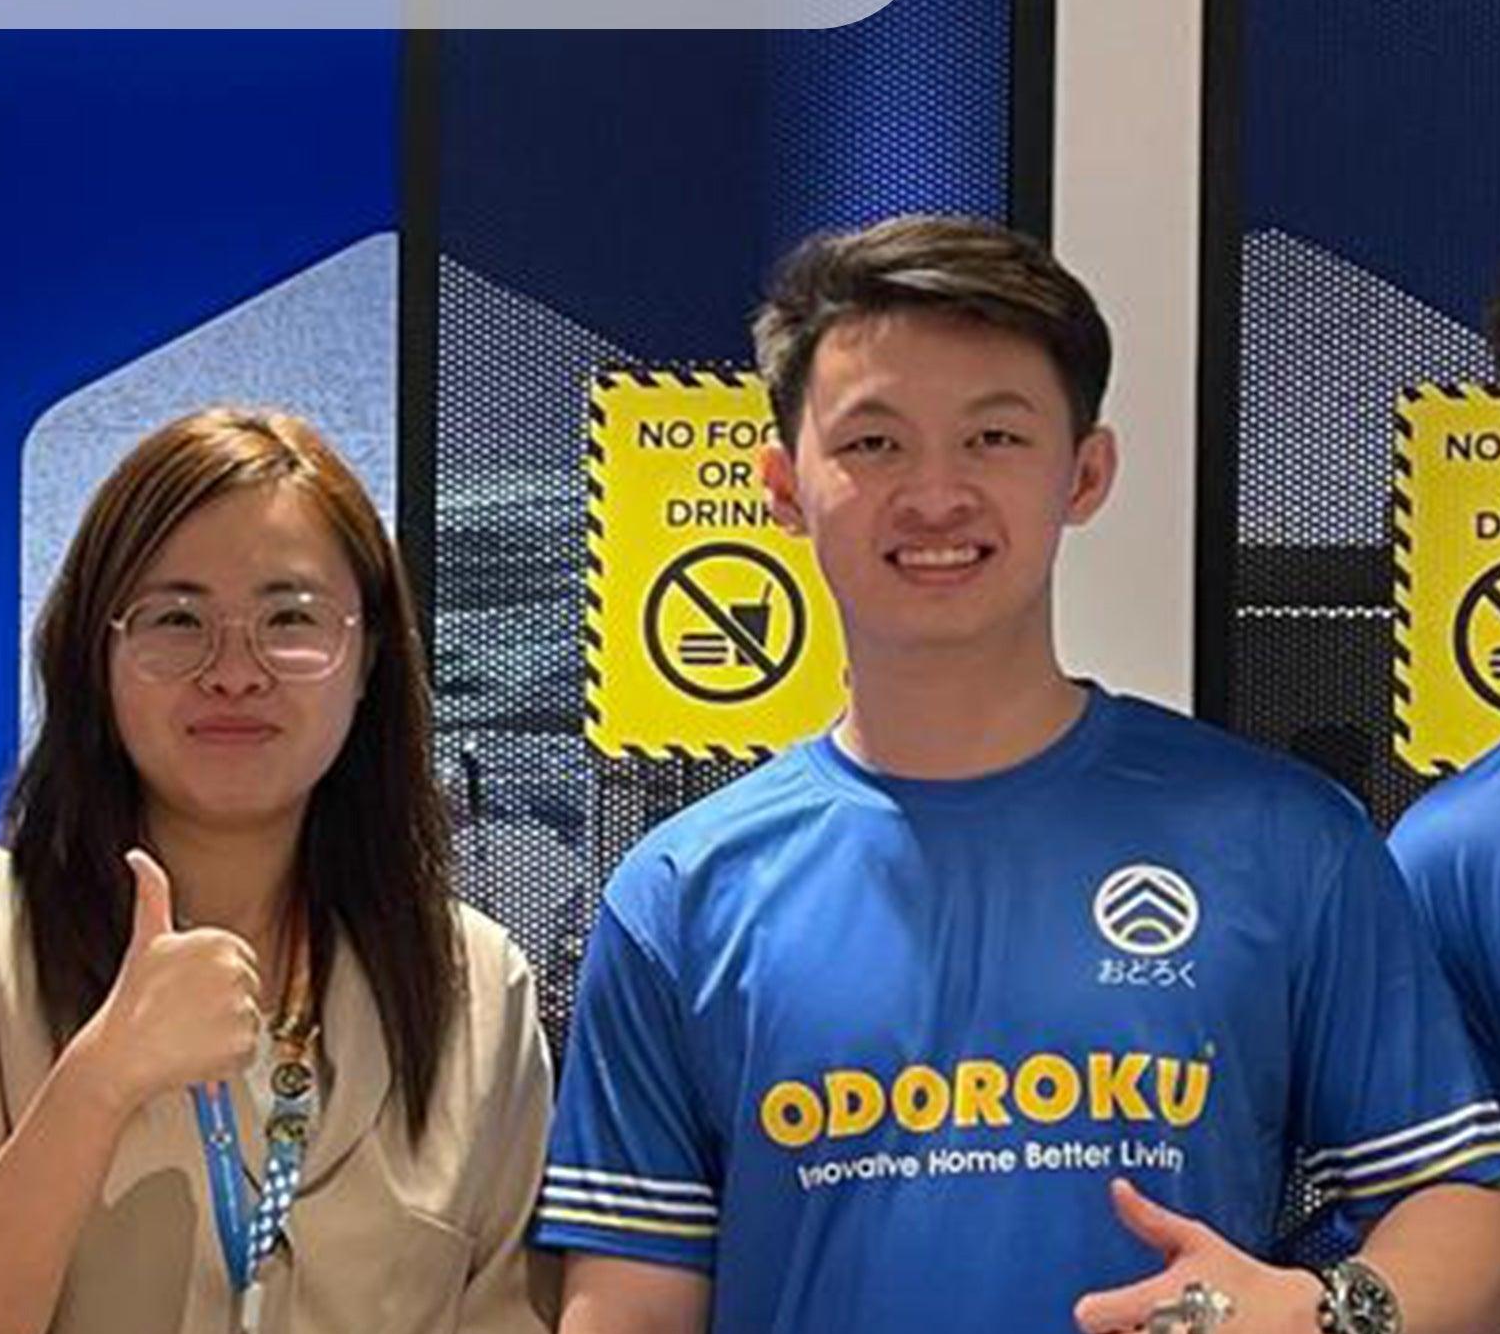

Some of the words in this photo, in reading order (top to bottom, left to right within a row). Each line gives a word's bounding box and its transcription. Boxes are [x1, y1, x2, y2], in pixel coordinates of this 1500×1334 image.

[638, 421, 695, 449] NO
[699, 461, 751, 488] OR
[1099, 959, 1196, 989] おどろく
[760, 1052, 1211, 1148] ODOROKU
[929, 1147, 1016, 1175] Home
[1025, 1141, 1111, 1169] Better
